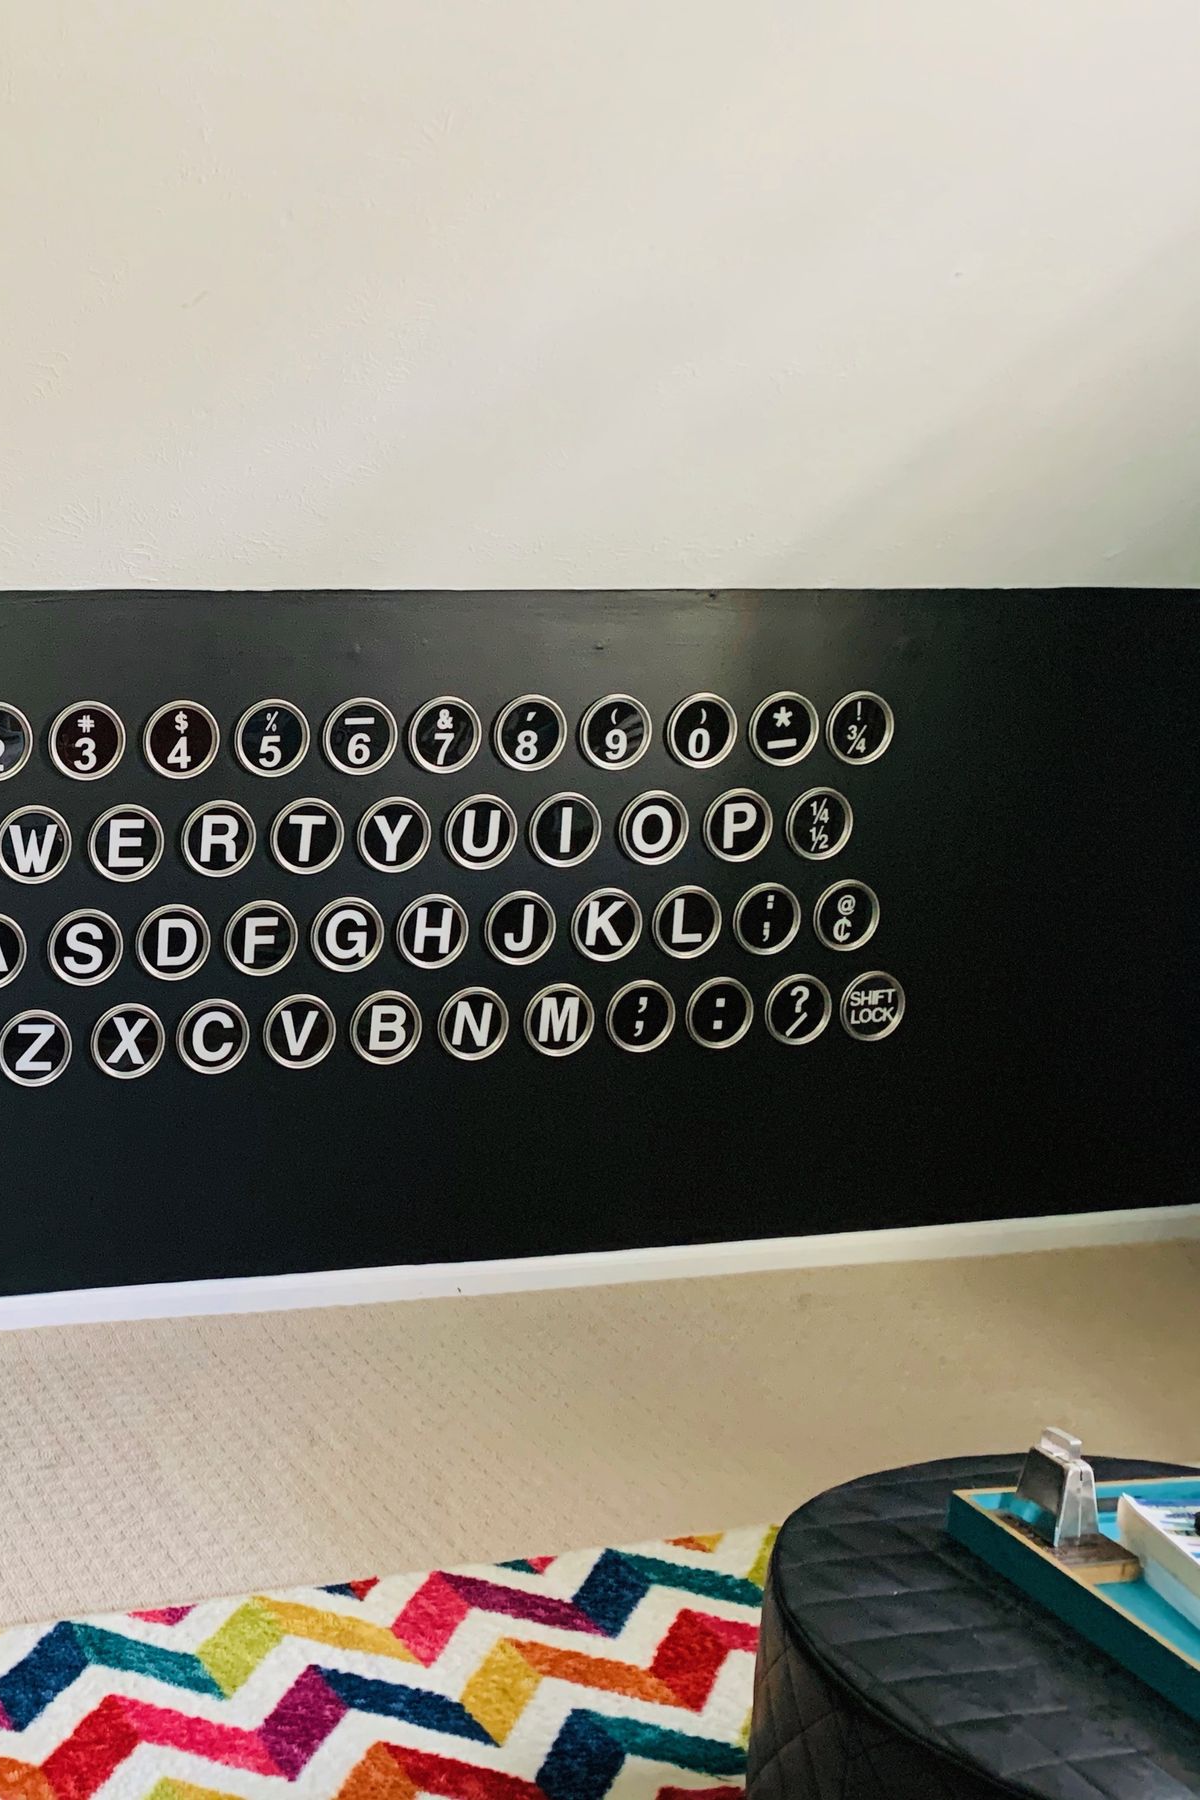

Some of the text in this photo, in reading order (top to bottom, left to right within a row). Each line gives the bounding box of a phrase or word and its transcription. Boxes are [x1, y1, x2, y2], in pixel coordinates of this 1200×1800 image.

[77, 714, 95, 733] #
[174, 710, 189, 734] $
[265, 710, 279, 732] %
[436, 708, 454, 730] &
[610, 708, 618, 725] (
[700, 708, 707, 725] )
[74, 737, 97, 771] 3
[166, 736, 192, 769] 4
[258, 735, 282, 768] 5
[347, 732, 371, 765] 6
[434, 732, 455, 766] 7
[515, 730, 538, 762] 8
[605, 728, 628, 760] 9
[8, 823, 58, 874] W
[108, 818, 145, 867] E
[200, 814, 238, 863] R
[288, 814, 327, 862] T
[373, 814, 413, 862] Y
[462, 809, 501, 857] U
[559, 806, 573, 853] I
[631, 805, 673, 854] O
[723, 802, 757, 849] P
[63, 923, 104, 974] S
[156, 918, 198, 967] D
[243, 916, 279, 964] F
[325, 909, 368, 959] G
[413, 906, 454, 954] H
[504, 904, 535, 952] J
[585, 900, 626, 946] K
[671, 898, 703, 944] L
[837, 894, 856, 915] @
[790, 985, 810, 1013] ?
[849, 988, 896, 1007] SHIFT
[15, 996, 580, 1071] Z X C V B N M
[850, 1006, 896, 1026] LOCK
